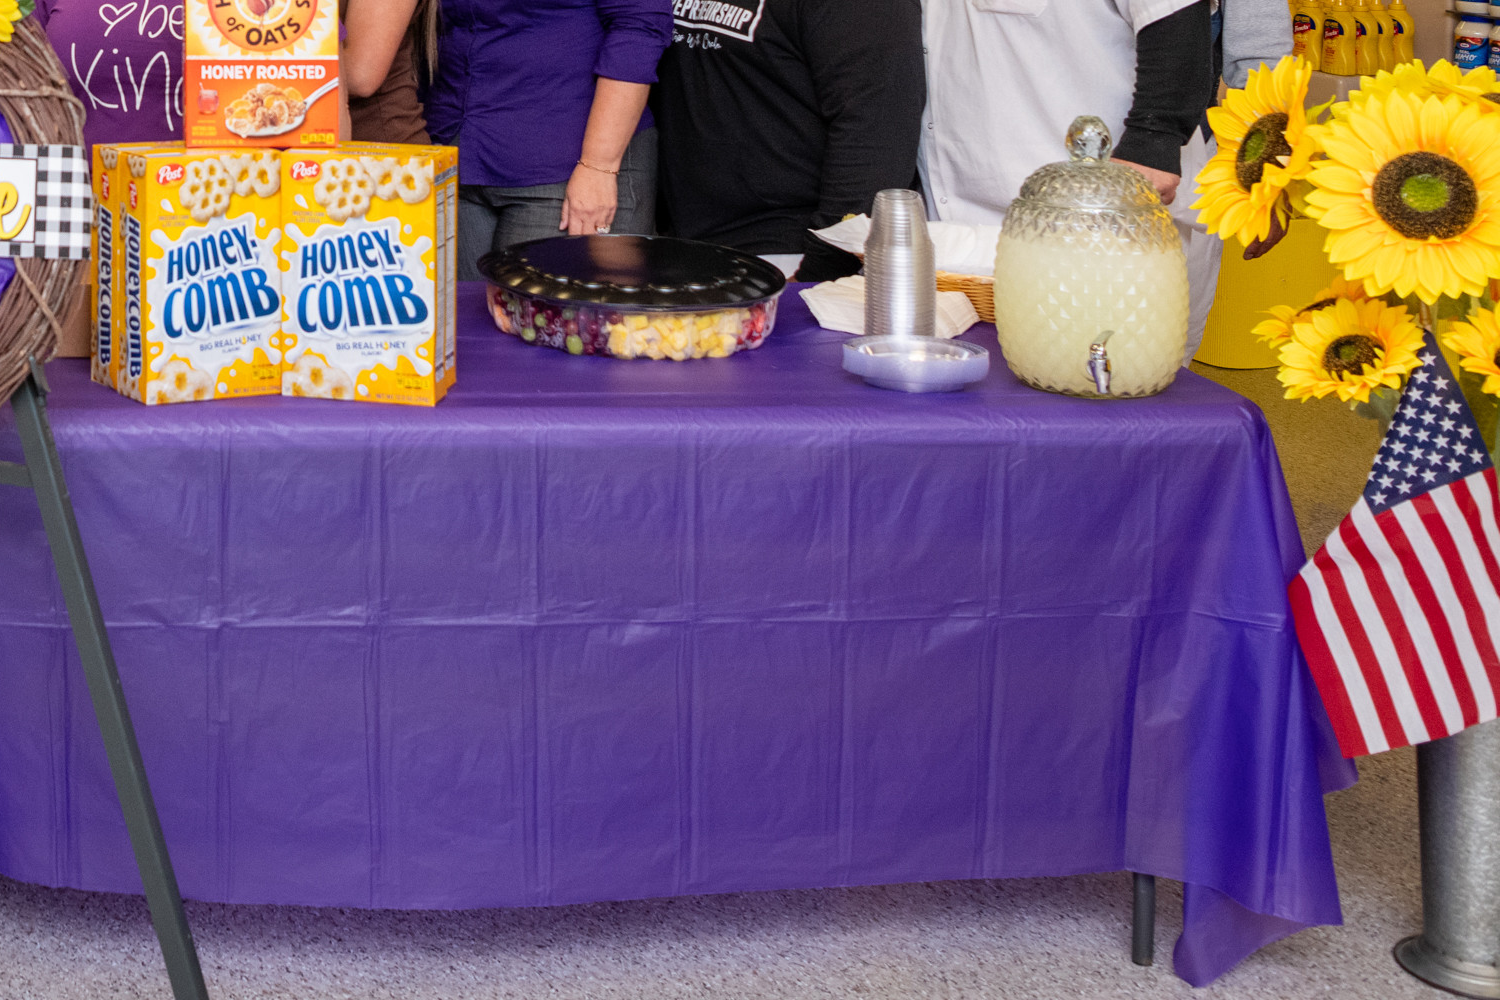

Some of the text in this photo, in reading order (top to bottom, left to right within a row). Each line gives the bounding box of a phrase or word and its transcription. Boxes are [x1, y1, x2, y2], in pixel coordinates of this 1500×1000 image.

[226, 16, 302, 46] of OATS
[200, 64, 326, 80] HONEY ROASTED
[158, 165, 183, 183] Post
[292, 161, 319, 179] Post
[163, 266, 280, 339] COMB
[296, 273, 429, 334] COMB
[199, 341, 213, 352] BIG
[214, 338, 234, 351] REAL
[335, 342, 351, 351] BIG
[352, 341, 374, 350] REAL
